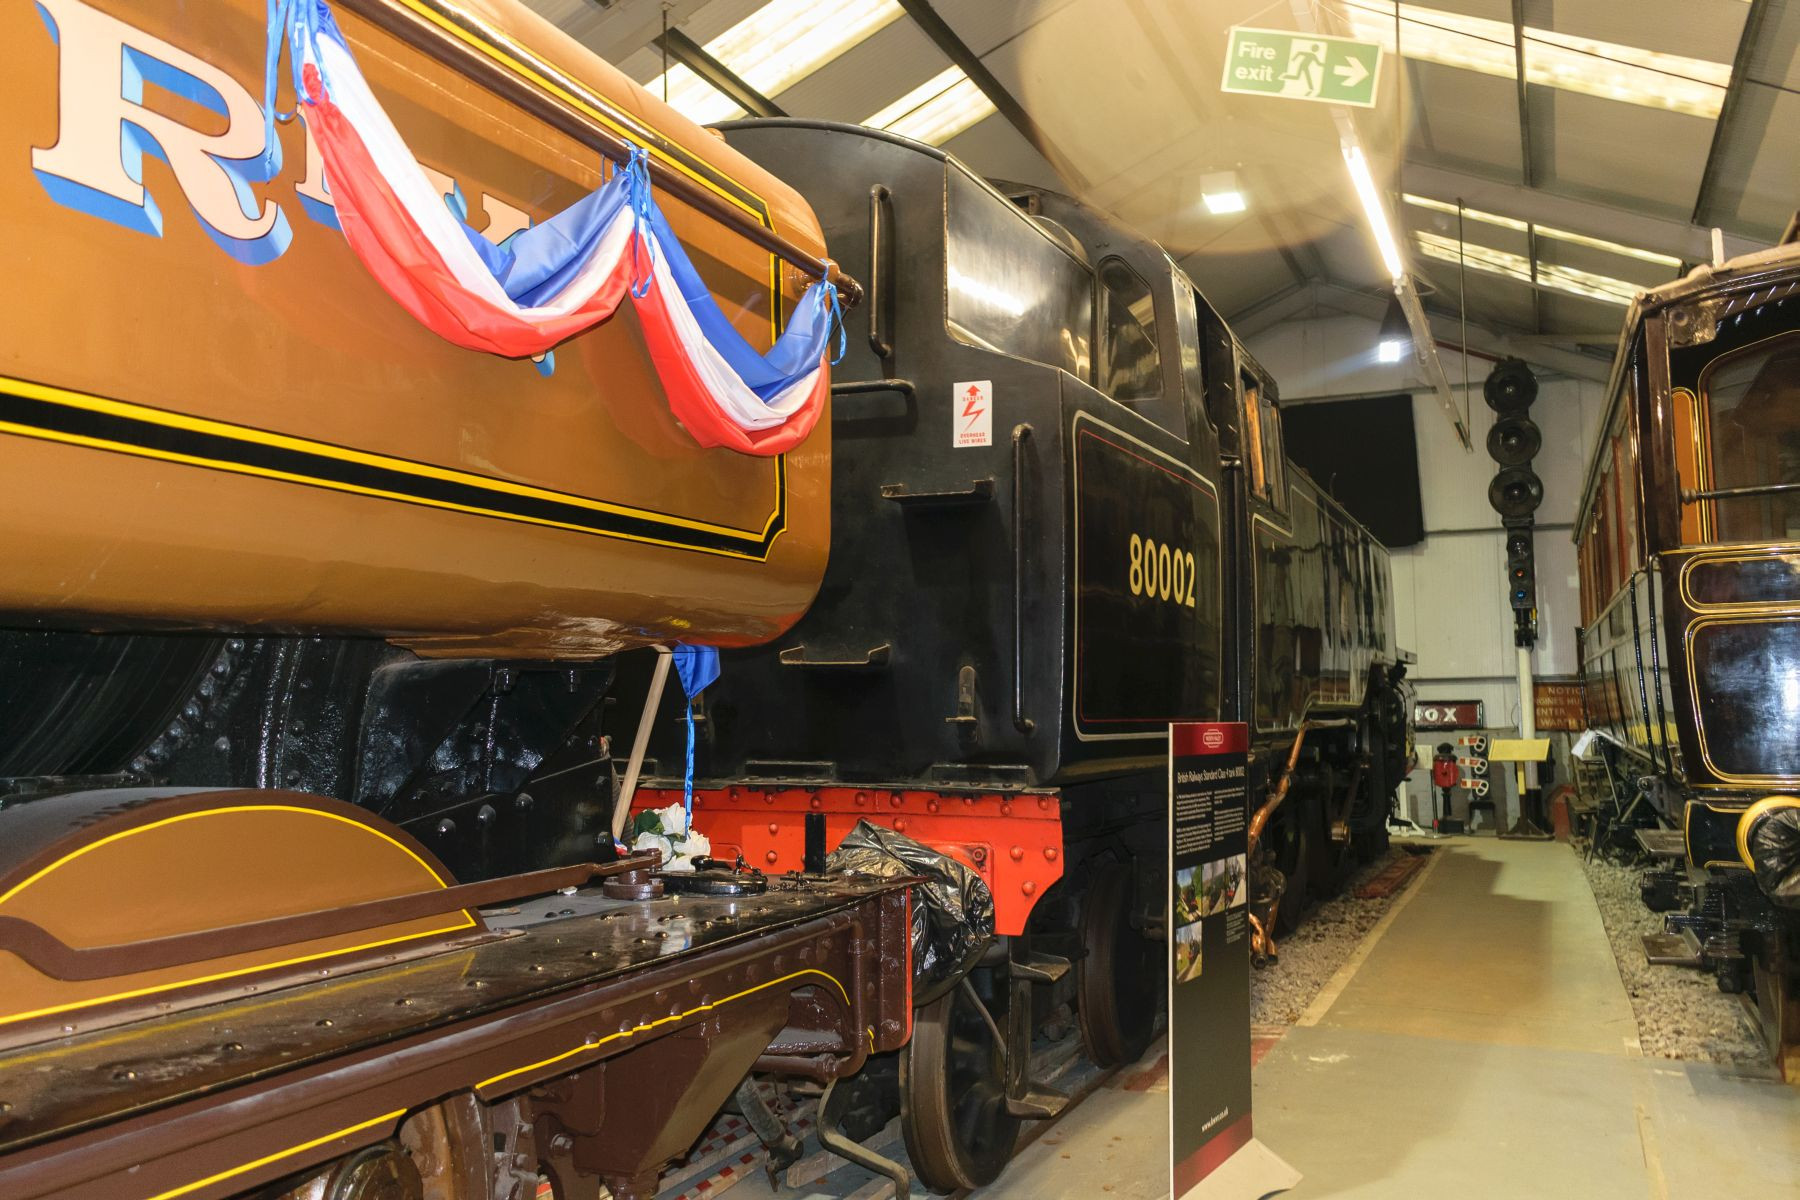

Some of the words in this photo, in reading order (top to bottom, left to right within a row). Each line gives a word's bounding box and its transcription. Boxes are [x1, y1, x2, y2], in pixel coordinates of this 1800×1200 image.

[1238, 41, 1276, 60] Fire
[1235, 64, 1274, 82] exit
[1129, 533, 1195, 608] 80002
[1548, 687, 1581, 695] NOTIC
